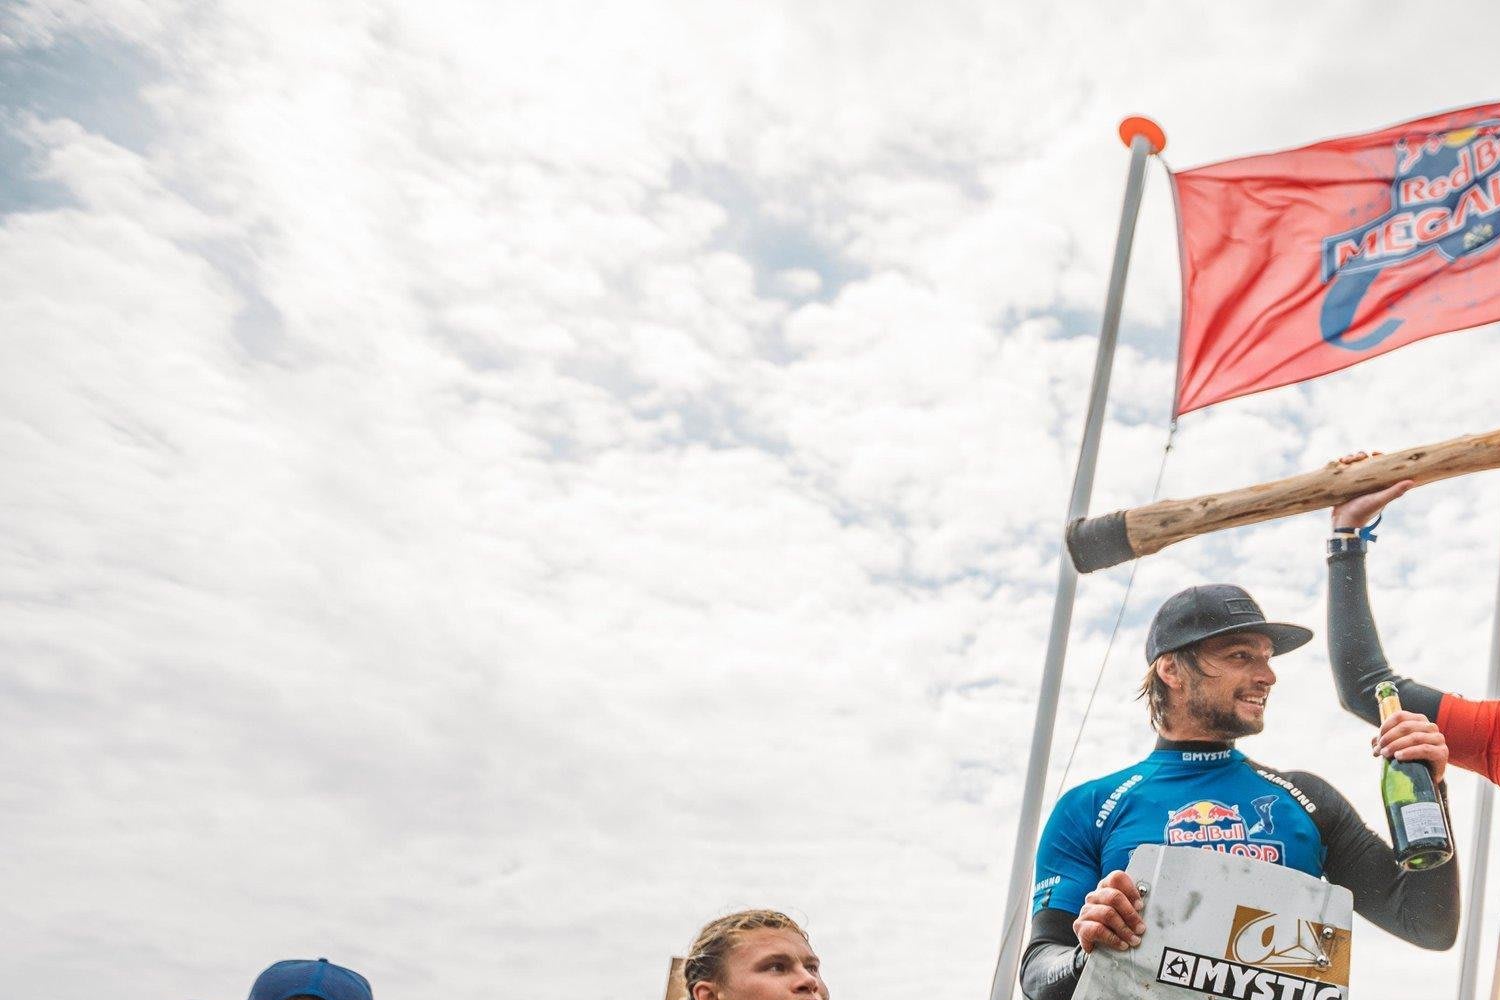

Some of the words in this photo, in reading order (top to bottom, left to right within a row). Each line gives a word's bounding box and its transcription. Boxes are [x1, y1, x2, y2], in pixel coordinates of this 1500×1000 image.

[1401, 149, 1471, 205] Red
[1192, 749, 1231, 761] MYSTIC
[1095, 774, 1143, 828] SAMSUNG
[1169, 825, 1207, 844] Red
[1208, 823, 1245, 841] Bull
[1034, 875, 1061, 893] MSUNG
